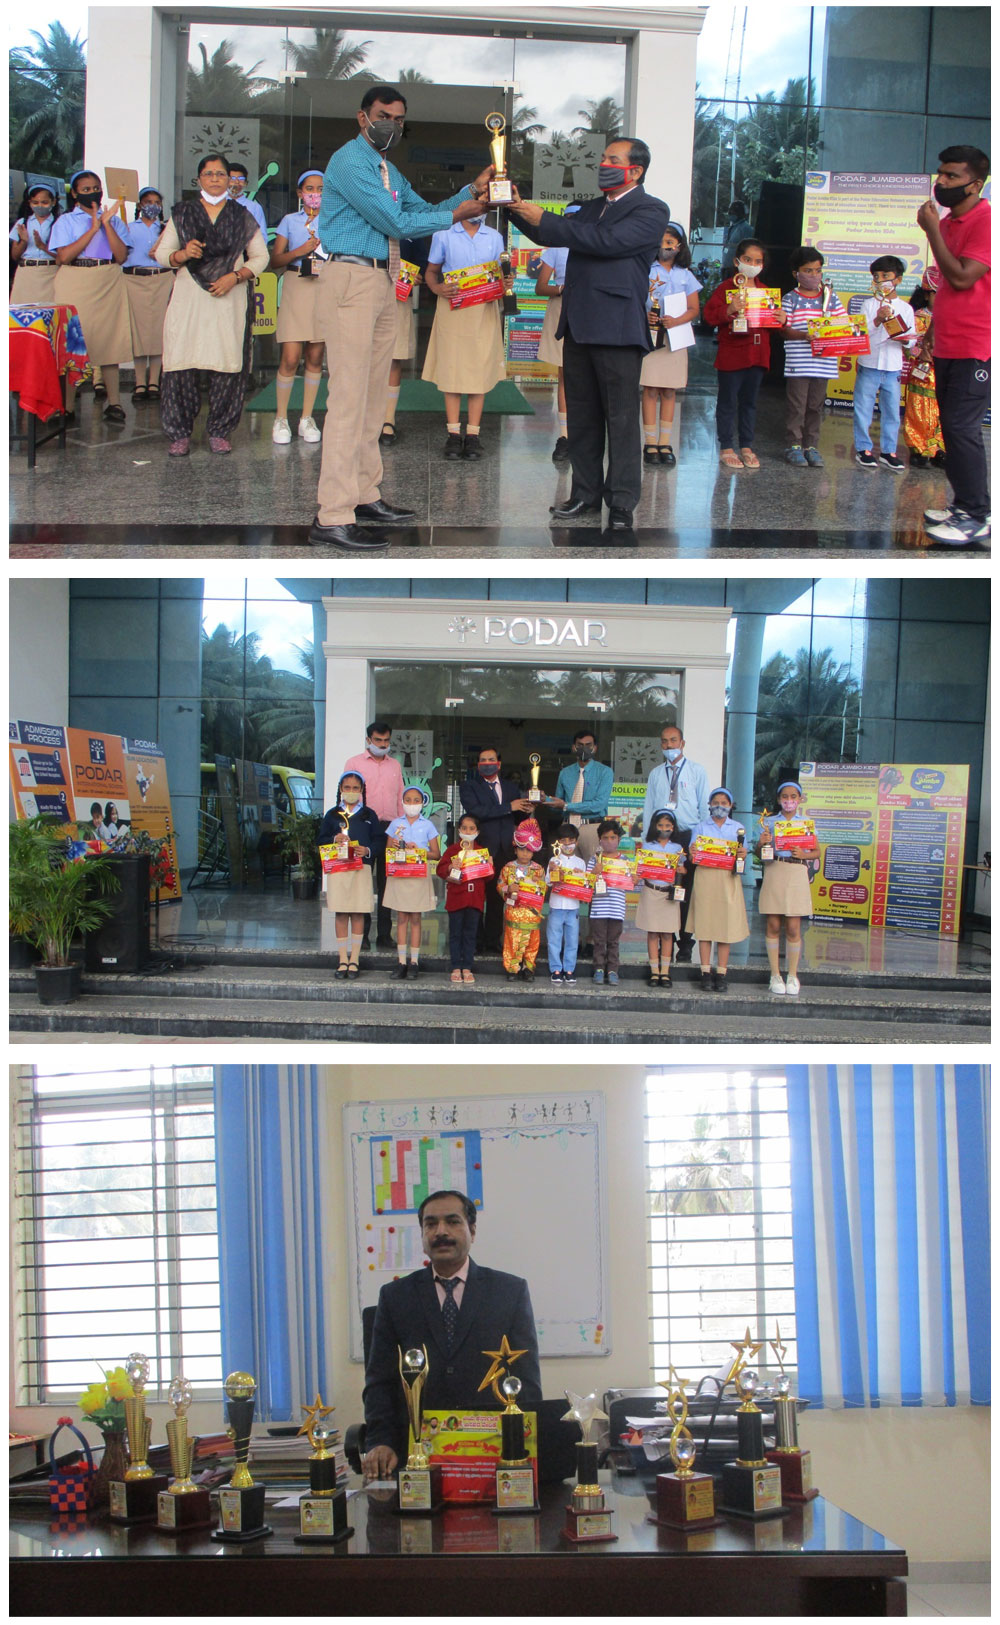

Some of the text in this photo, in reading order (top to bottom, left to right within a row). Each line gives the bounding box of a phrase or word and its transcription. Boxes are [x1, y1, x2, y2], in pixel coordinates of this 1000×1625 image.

[540, 191, 568, 200] Since
[807, 217, 819, 232] 5
[911, 259, 924, 274] 2
[254, 318, 274, 326] HOOL
[838, 356, 852, 372] 5
[484, 617, 608, 647] PODAR
[24, 725, 62, 737] ADMISSION
[28, 734, 61, 745] PROCESS
[134, 740, 157, 749] PODAR
[55, 752, 59, 761] 1
[75, 765, 122, 782] PODAR
[915, 775, 940, 785] Jumbo
[60, 793, 65, 801] 2
[865, 821, 874, 831] 2
[861, 860, 871, 870] 4
[818, 886, 827, 896] 5
